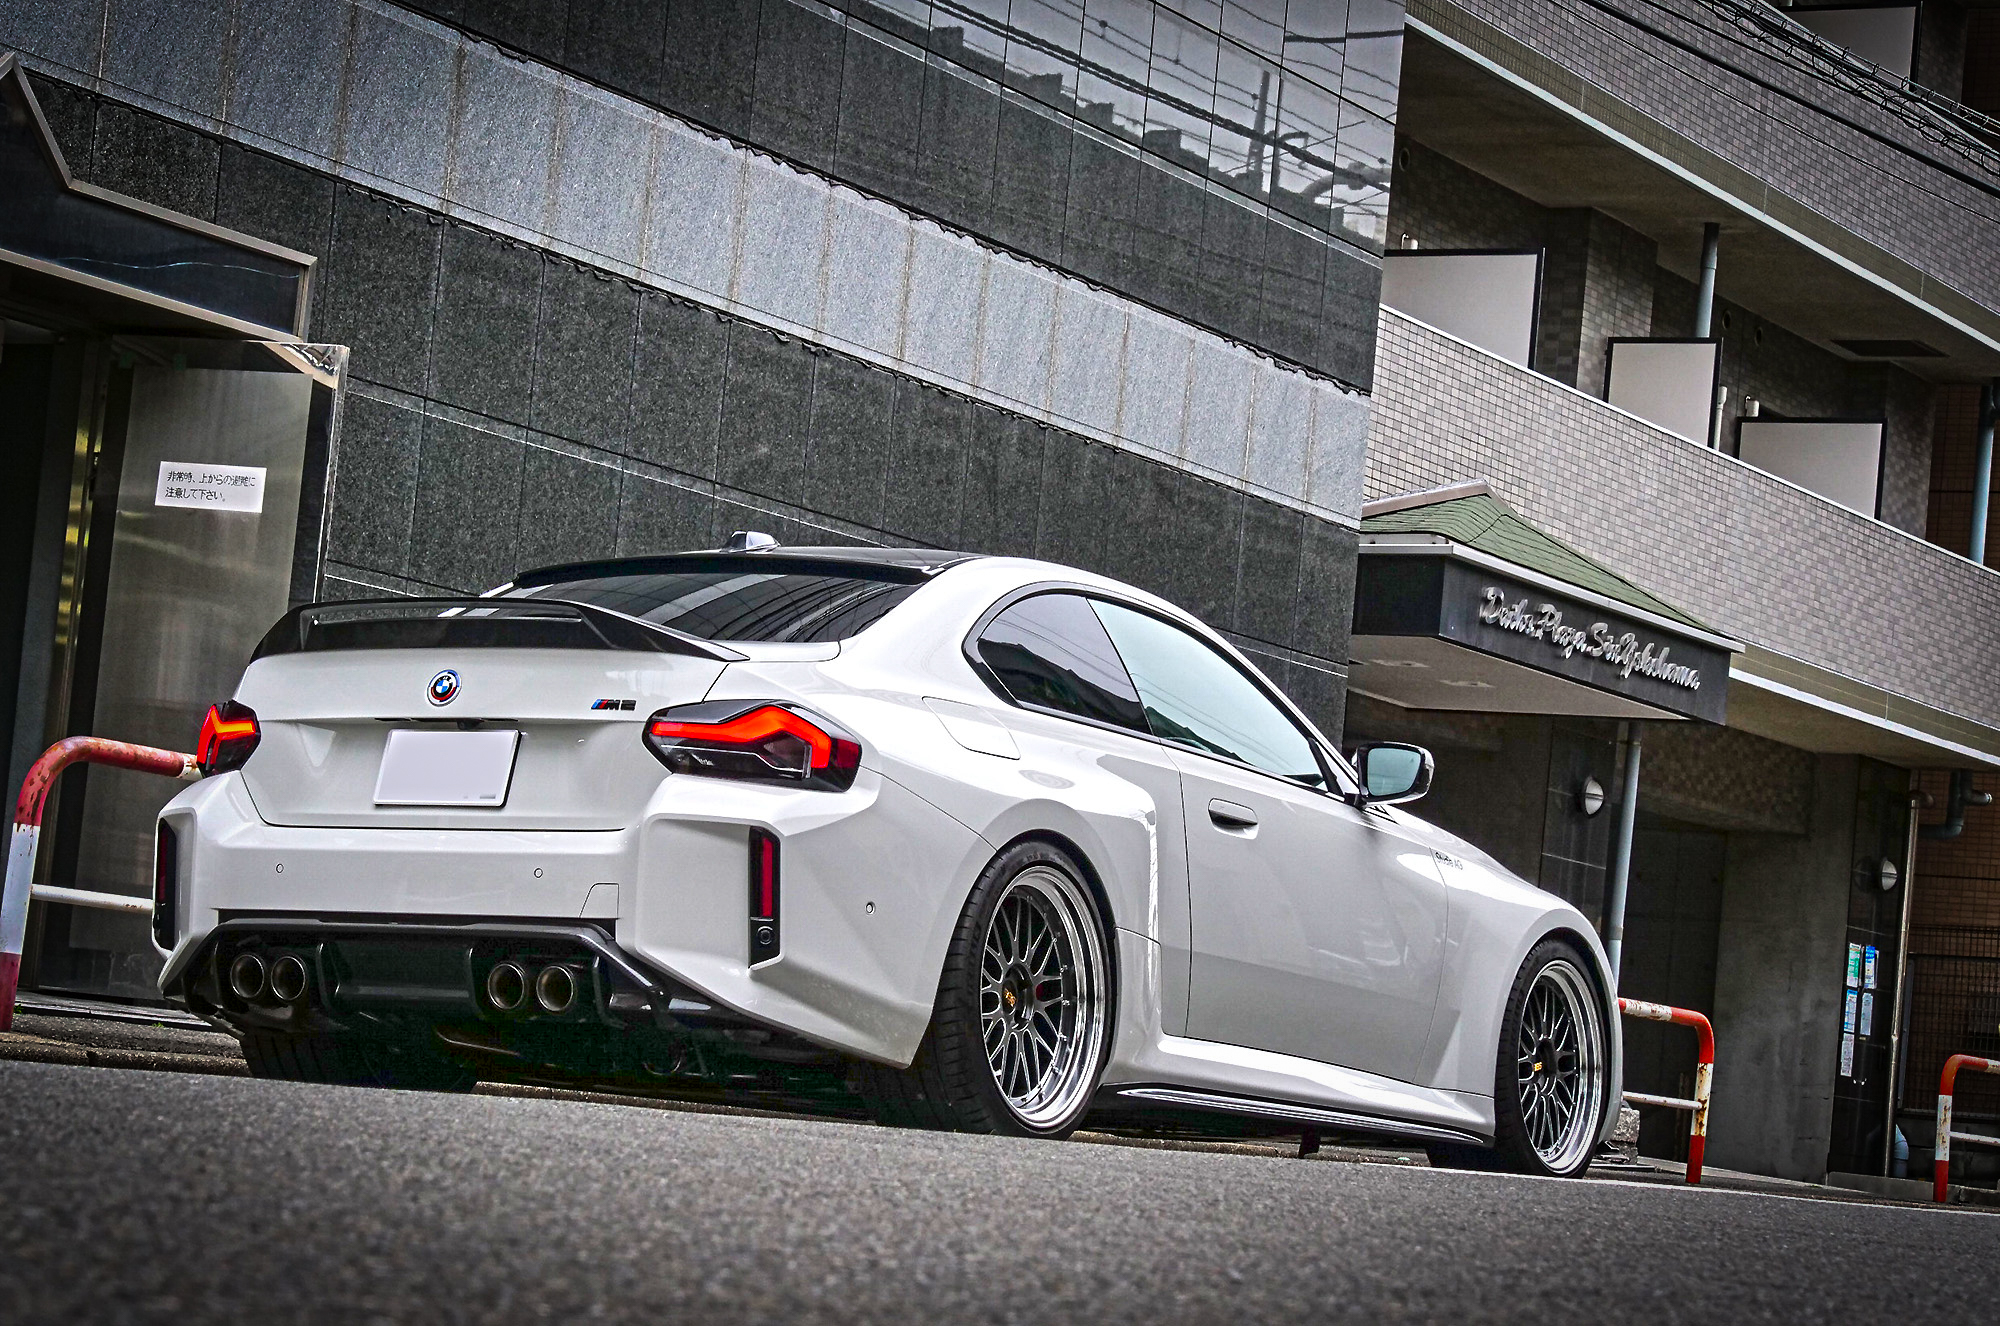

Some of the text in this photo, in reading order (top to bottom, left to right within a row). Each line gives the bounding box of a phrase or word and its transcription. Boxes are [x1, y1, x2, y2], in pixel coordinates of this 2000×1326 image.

[167, 470, 256, 487] 非常時、上からの避難に
[165, 486, 226, 502] 注意して下さい。
